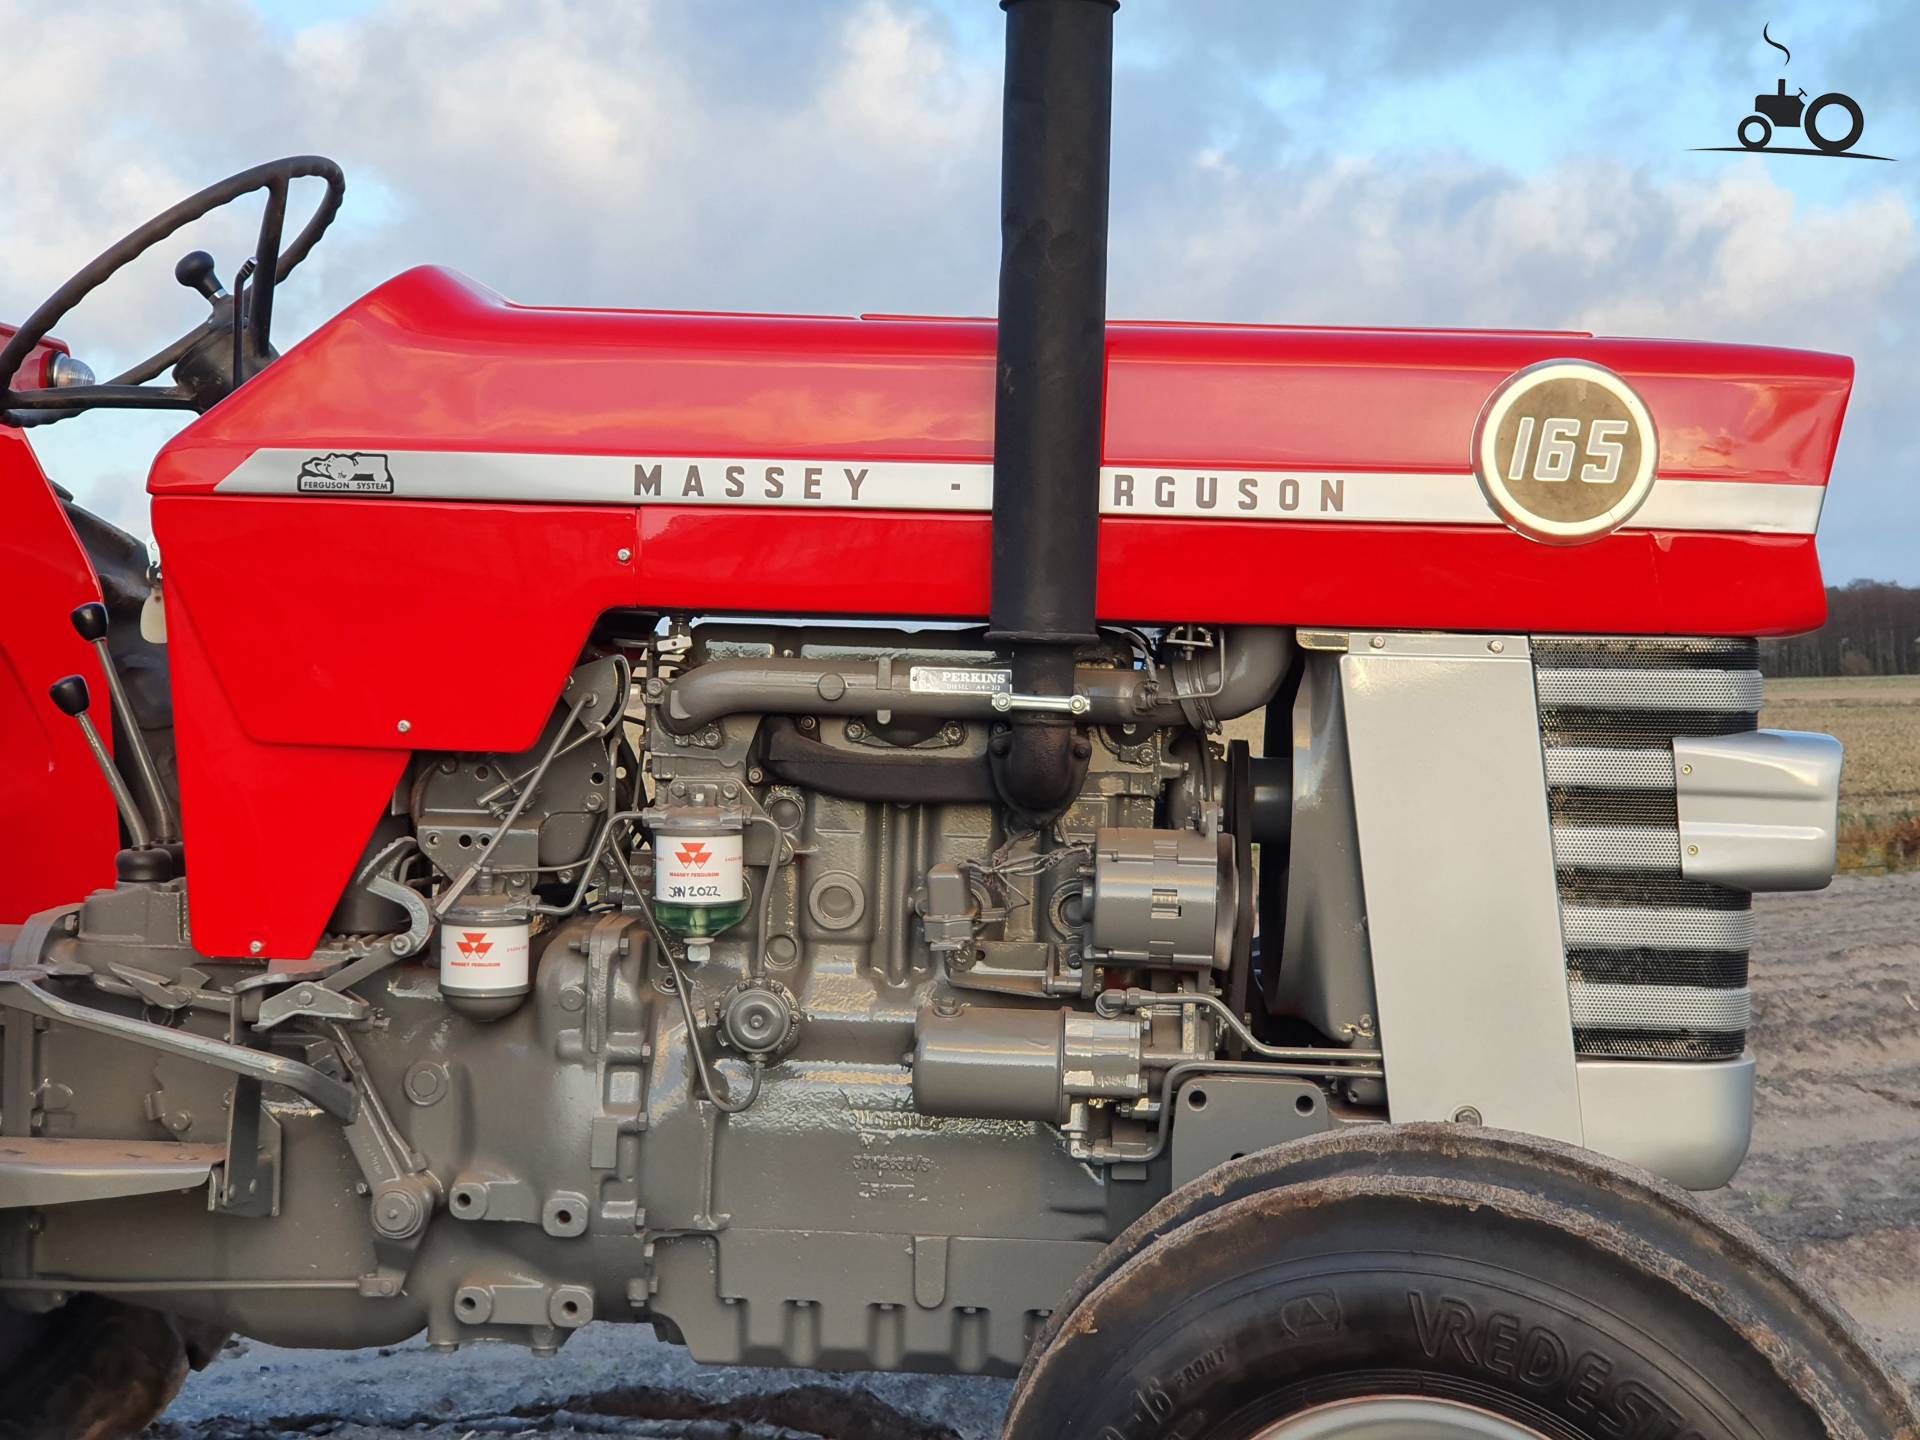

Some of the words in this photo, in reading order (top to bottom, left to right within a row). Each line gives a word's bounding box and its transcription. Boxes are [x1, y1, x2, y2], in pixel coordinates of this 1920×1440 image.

[1508, 416, 1629, 483] 165
[303, 481, 350, 489] FERGUSON
[356, 481, 388, 490] SYSTEM
[633, 463, 869, 500] MASSEY
[1113, 474, 1345, 512] RGUSON
[942, 671, 1006, 684] PERKINS
[668, 886, 686, 898] JAN
[688, 885, 721, 897] 2022
[1174, 1346, 1227, 1390] FRONT
[1406, 1288, 1708, 1440] VREDEST
